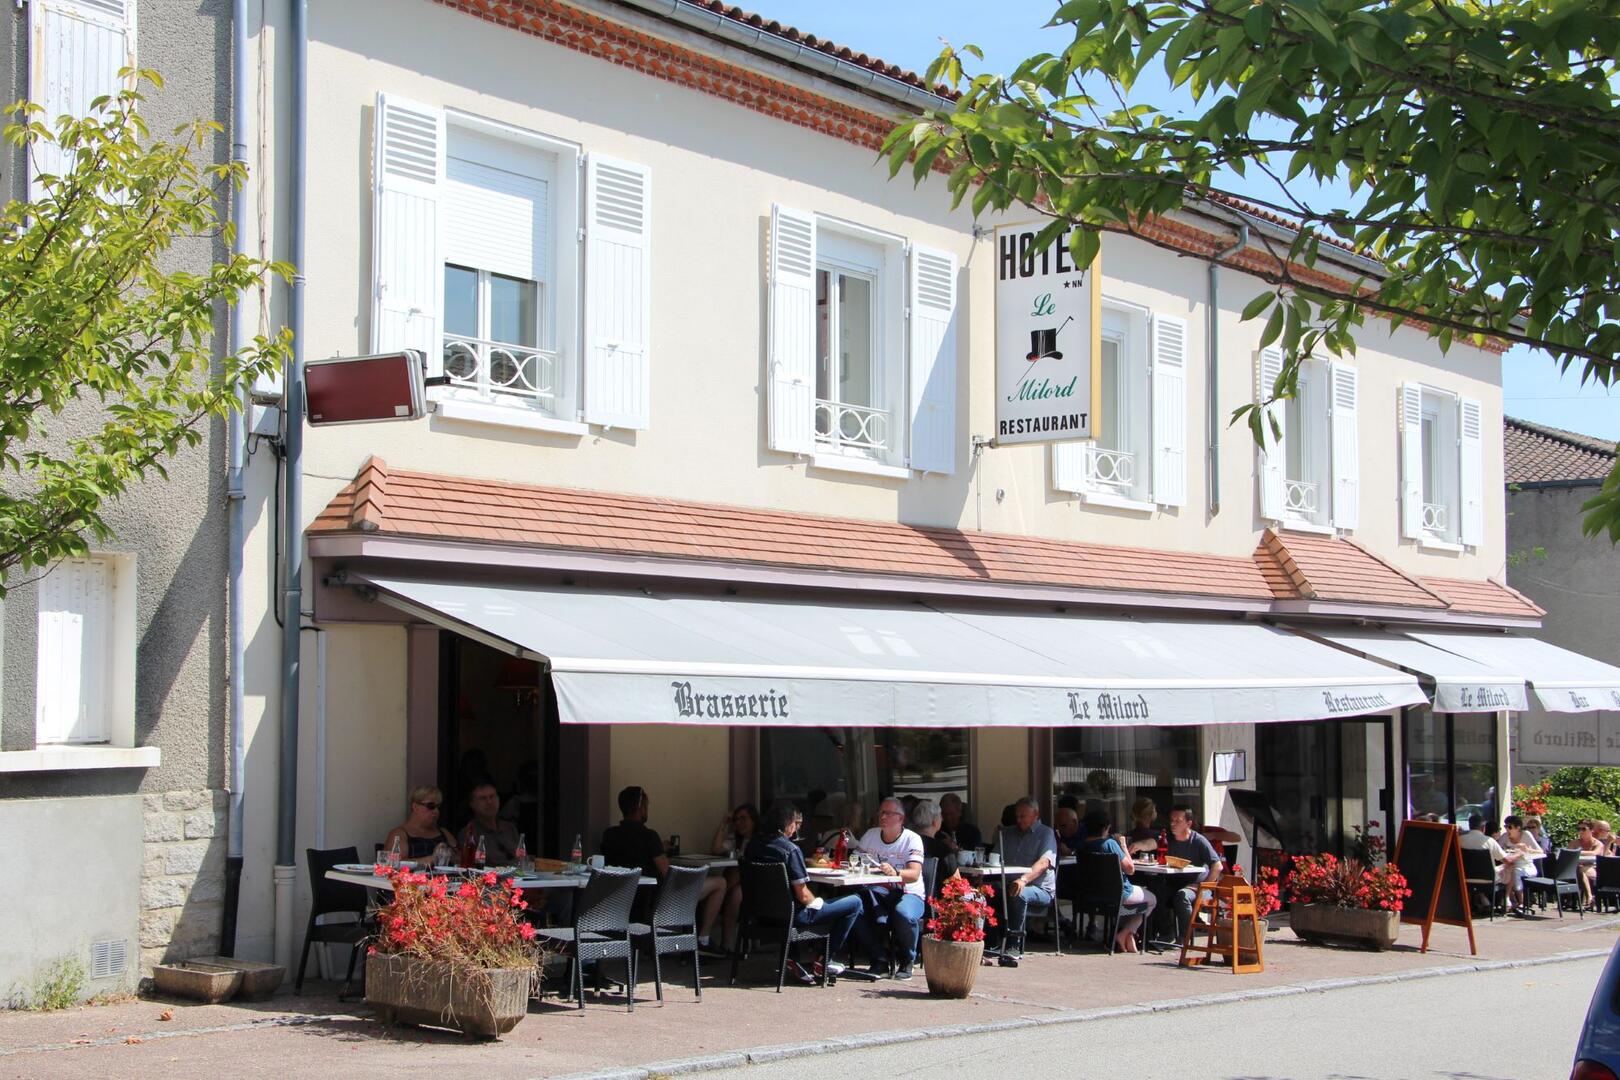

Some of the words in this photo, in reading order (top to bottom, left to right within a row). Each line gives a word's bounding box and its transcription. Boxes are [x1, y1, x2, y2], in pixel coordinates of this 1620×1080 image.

[1031, 293, 1056, 316] Le
[1007, 376, 1077, 402] Milord
[1000, 413, 1087, 435] RESTAURANT
[671, 681, 789, 718] Brasserie
[1067, 692, 1091, 719] Le
[1097, 692, 1149, 720] Milord
[1323, 691, 1392, 713] Restaurant
[1461, 687, 1472, 707] Le
[1477, 687, 1509, 707] Milord
